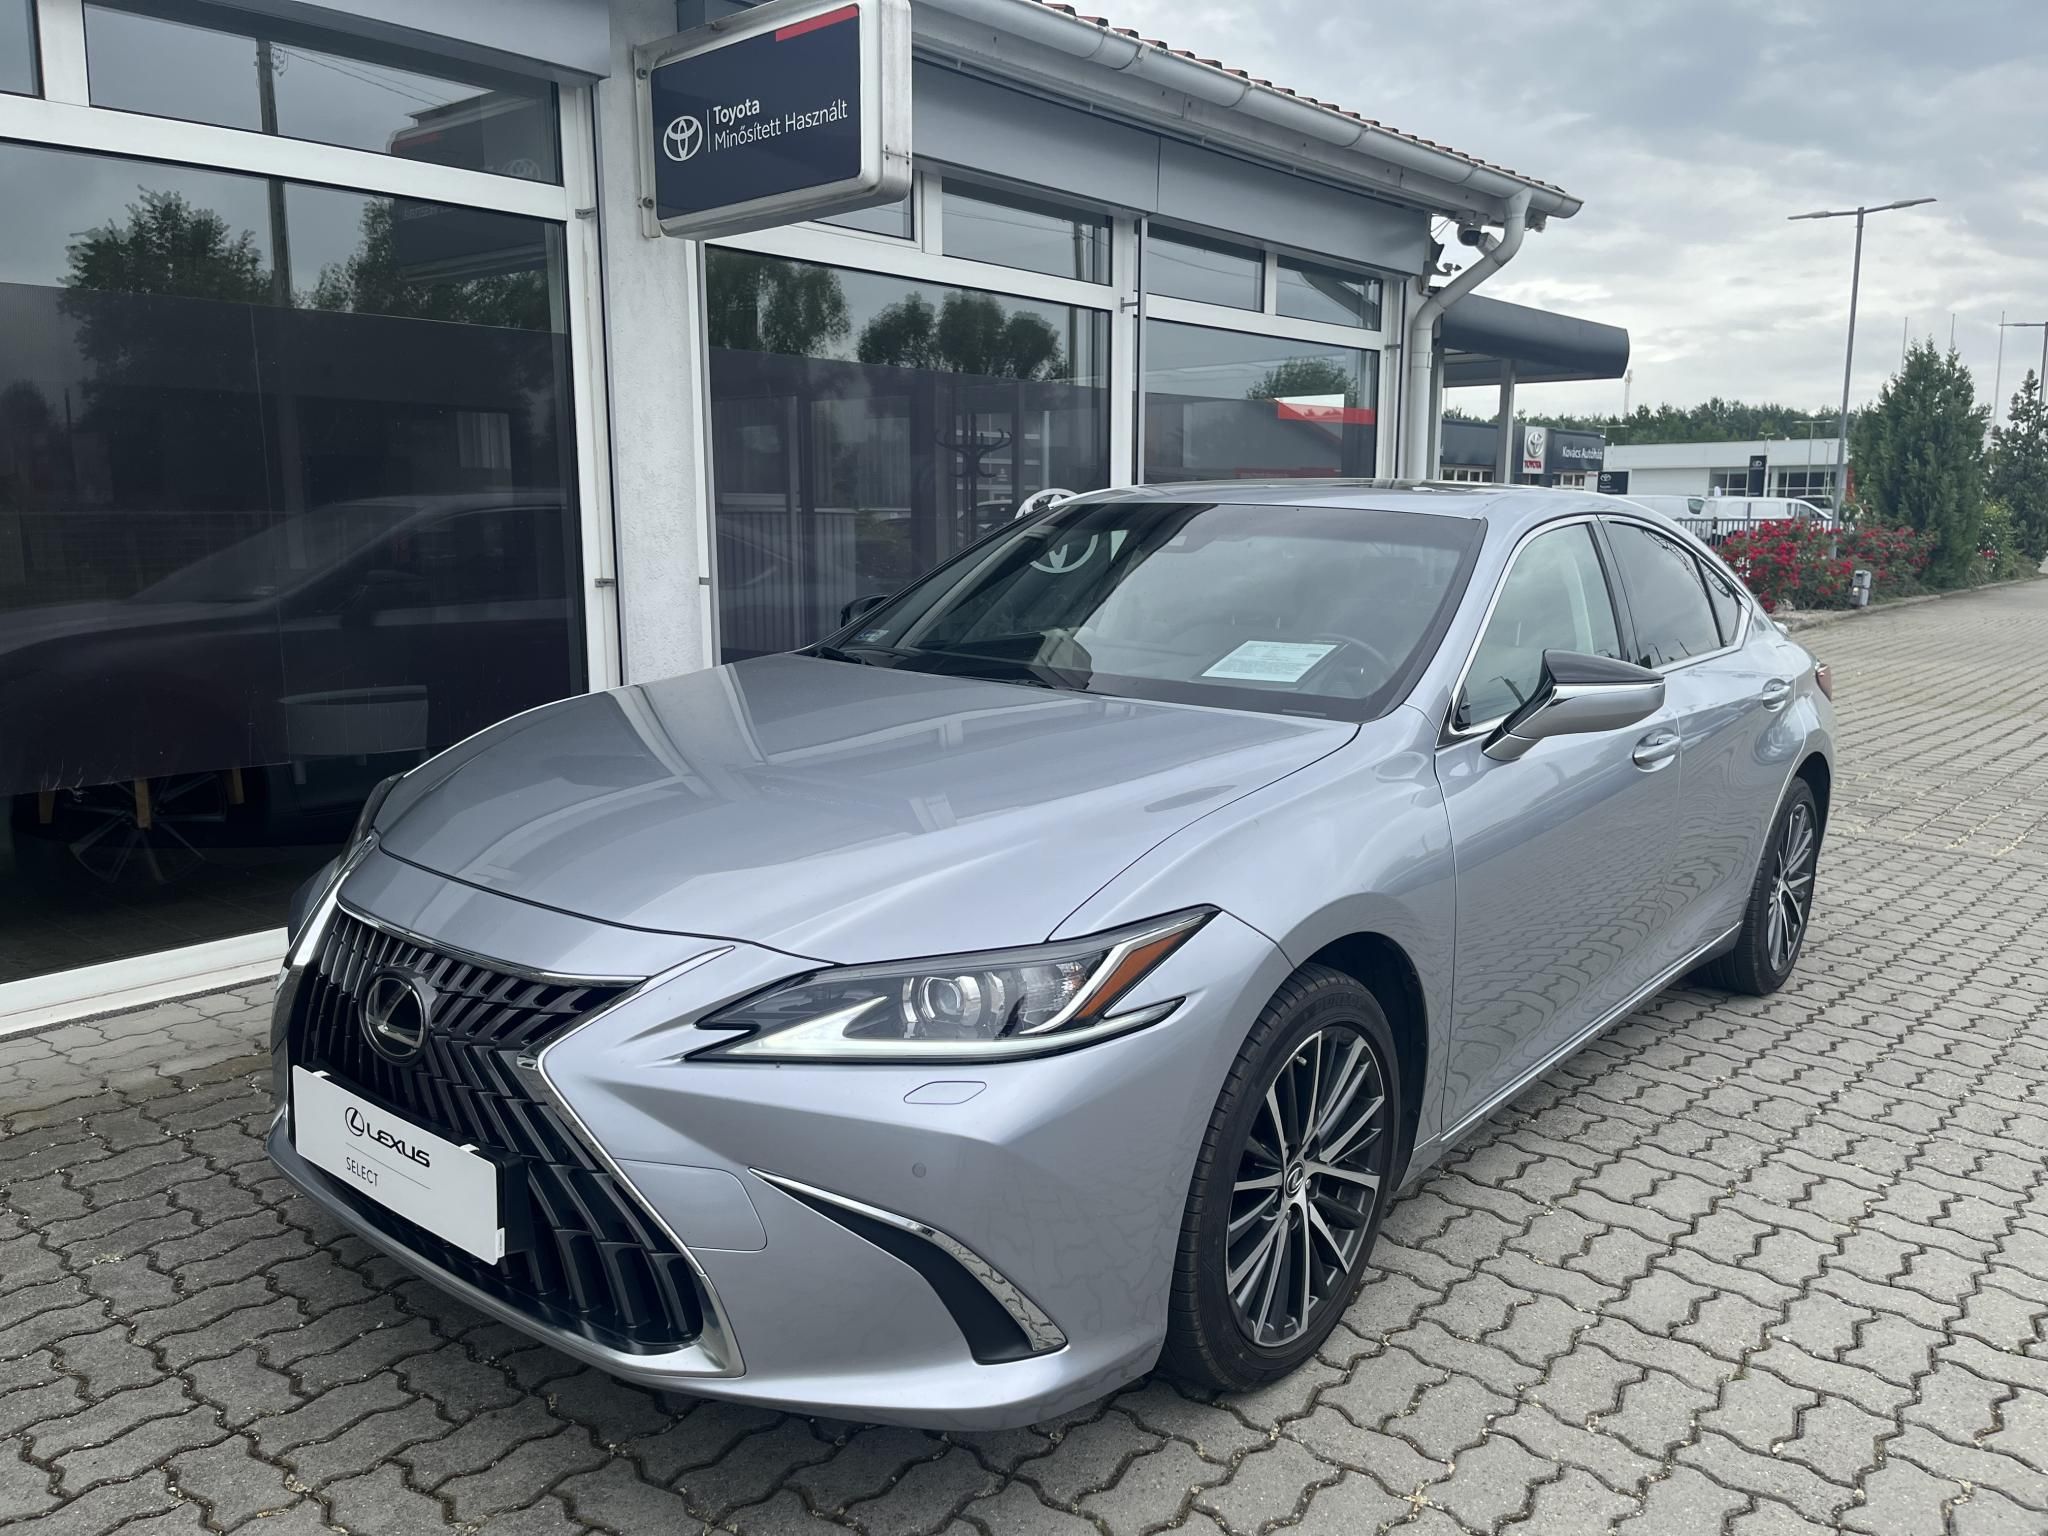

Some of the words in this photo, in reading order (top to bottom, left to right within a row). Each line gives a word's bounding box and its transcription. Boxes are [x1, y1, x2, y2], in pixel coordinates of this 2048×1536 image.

[713, 99, 760, 125] Toyota
[715, 117, 782, 151] Minősített
[785, 98, 848, 133] Használt
[1524, 460, 1541, 469] TOYOTA
[367, 1122, 430, 1168] LEXUS
[346, 1156, 379, 1187] SELECT
